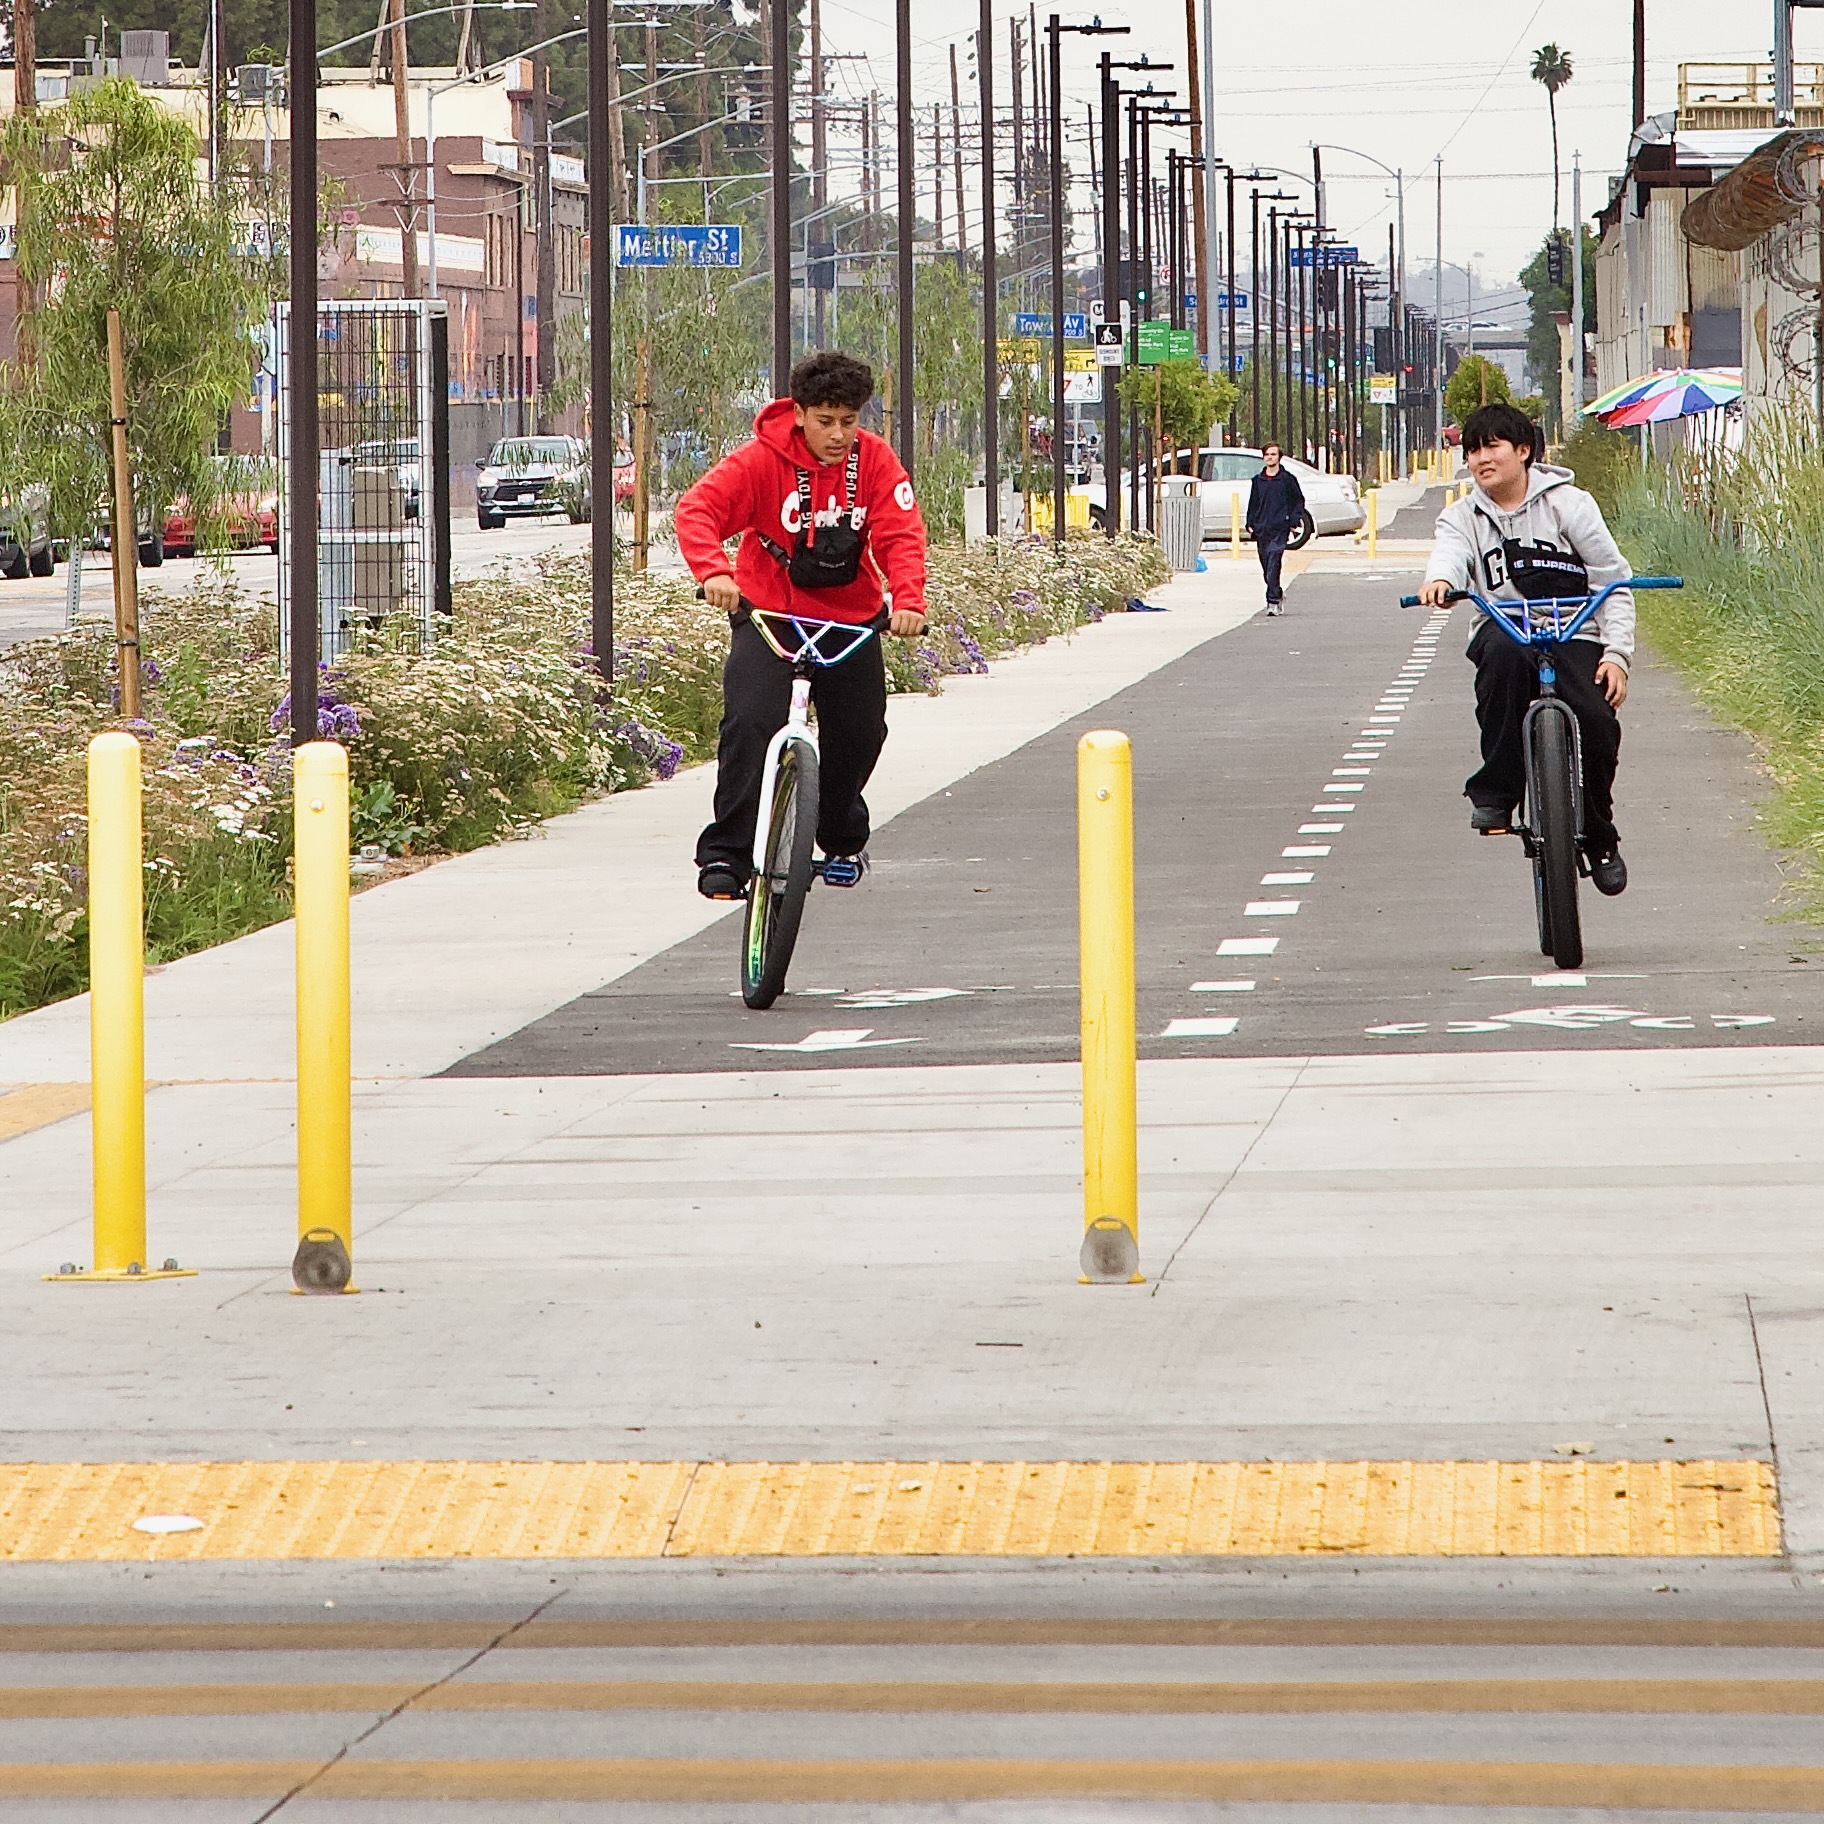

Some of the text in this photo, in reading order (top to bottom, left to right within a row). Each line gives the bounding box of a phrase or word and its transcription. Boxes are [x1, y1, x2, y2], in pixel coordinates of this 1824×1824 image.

[707, 228, 729, 251] St
[730, 251, 738, 264] S
[1063, 315, 1079, 329] Av
